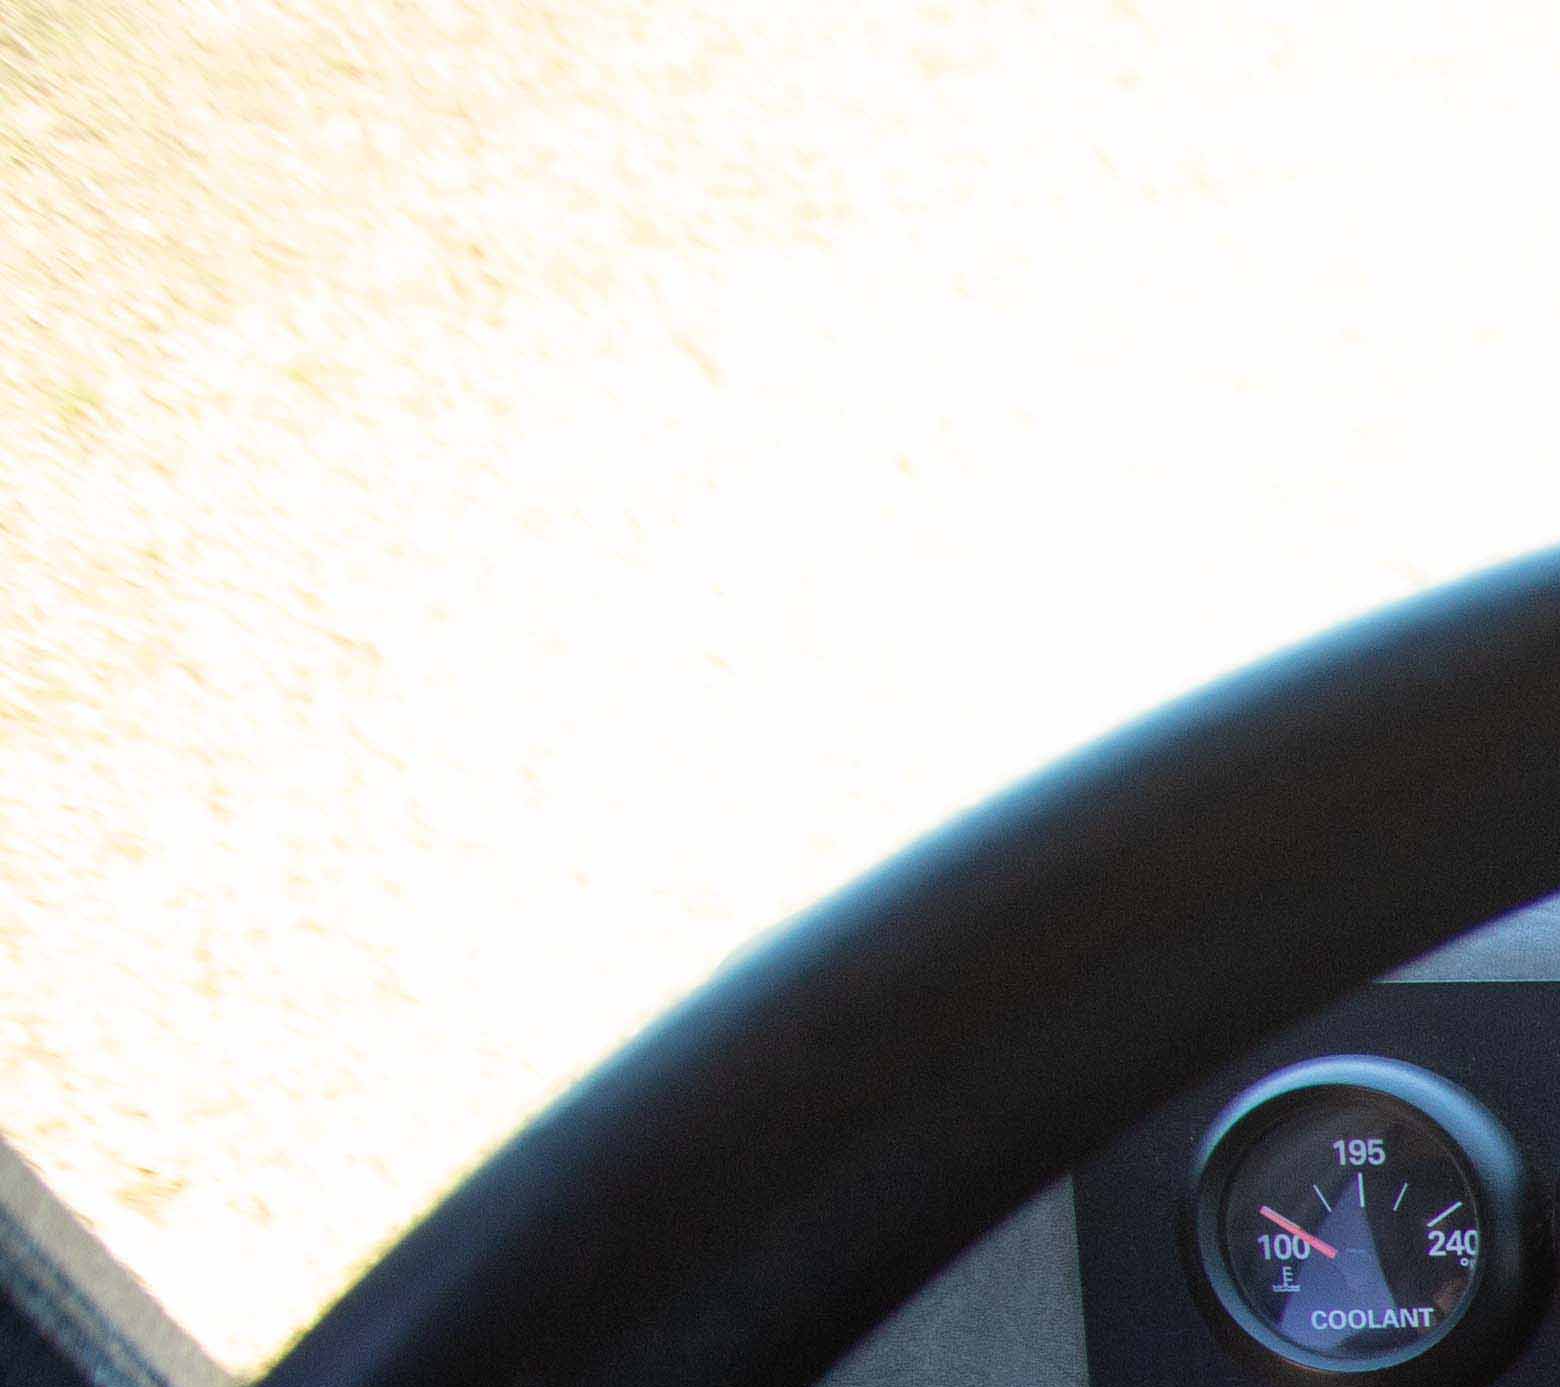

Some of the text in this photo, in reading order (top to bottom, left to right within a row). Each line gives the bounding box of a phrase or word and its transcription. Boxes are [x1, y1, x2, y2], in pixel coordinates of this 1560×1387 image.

[1333, 1139, 1386, 1166] 195
[1257, 1233, 1311, 1260] 100
[1426, 1230, 1479, 1257] 240
[1310, 1307, 1434, 1331] COOLANT
